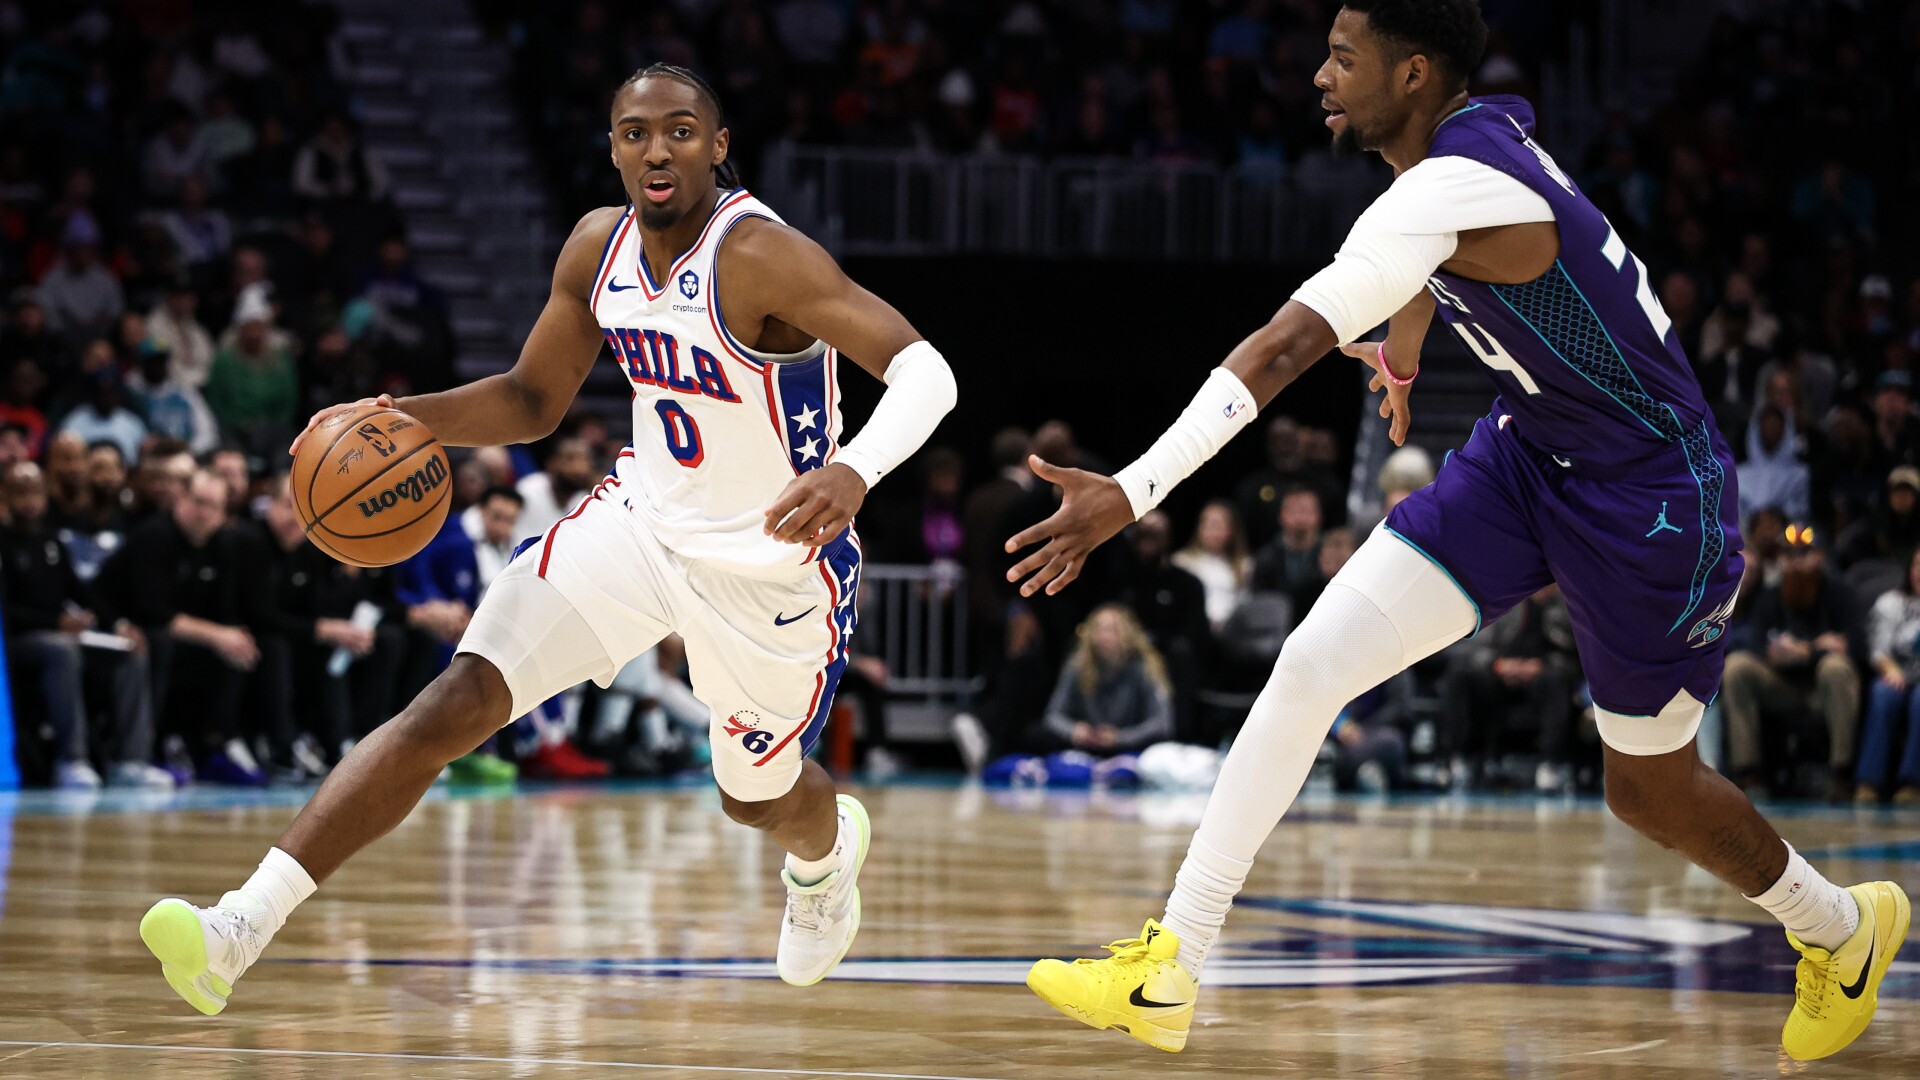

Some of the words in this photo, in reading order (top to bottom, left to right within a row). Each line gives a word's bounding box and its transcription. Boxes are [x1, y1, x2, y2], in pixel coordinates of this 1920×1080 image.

[672, 304, 707, 314] crypto.com
[602, 327, 743, 404] PHILA
[654, 399, 704, 469] 0
[357, 453, 448, 518] Wilson
